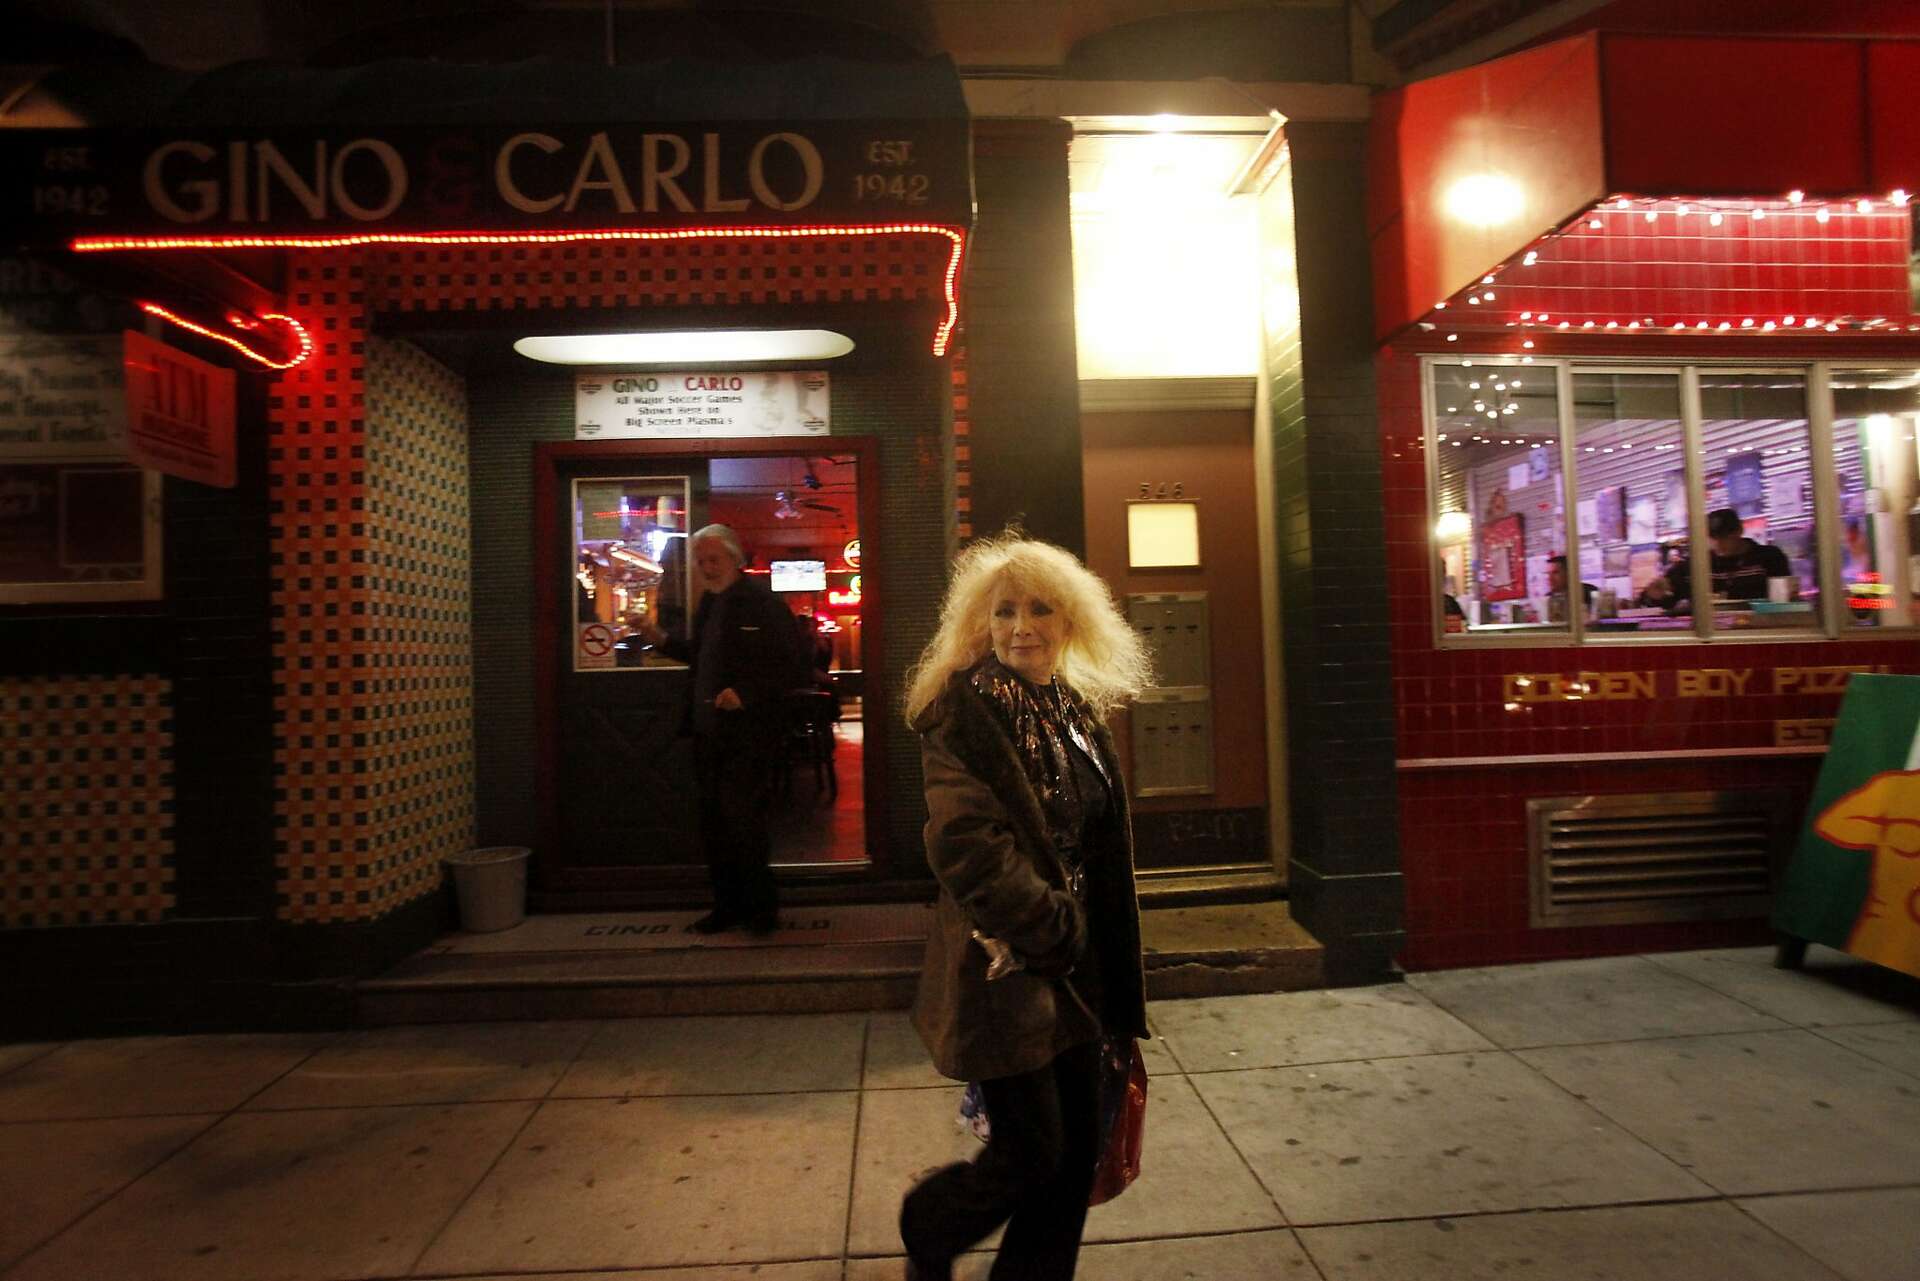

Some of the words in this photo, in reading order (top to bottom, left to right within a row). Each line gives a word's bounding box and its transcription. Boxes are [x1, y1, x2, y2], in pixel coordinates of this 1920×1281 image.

[142, 137, 410, 224] GINO
[494, 129, 825, 214] CARLO
[854, 173, 930, 201] 1942
[32, 184, 111, 216] 1942
[612, 378, 659, 393] GINO
[684, 376, 743, 392] CARLO
[616, 396, 629, 405] All
[634, 397, 664, 406] Major
[668, 395, 702, 405] Soccer
[707, 394, 743, 404] Games
[638, 406, 673, 415] Shown
[625, 417, 643, 428] Big
[647, 417, 682, 426] Screen
[1503, 671, 1655, 703] GOLDEN
[1676, 668, 1751, 698] BOY
[1774, 664, 1890, 695] PIZ
[583, 924, 672, 936] GINO
